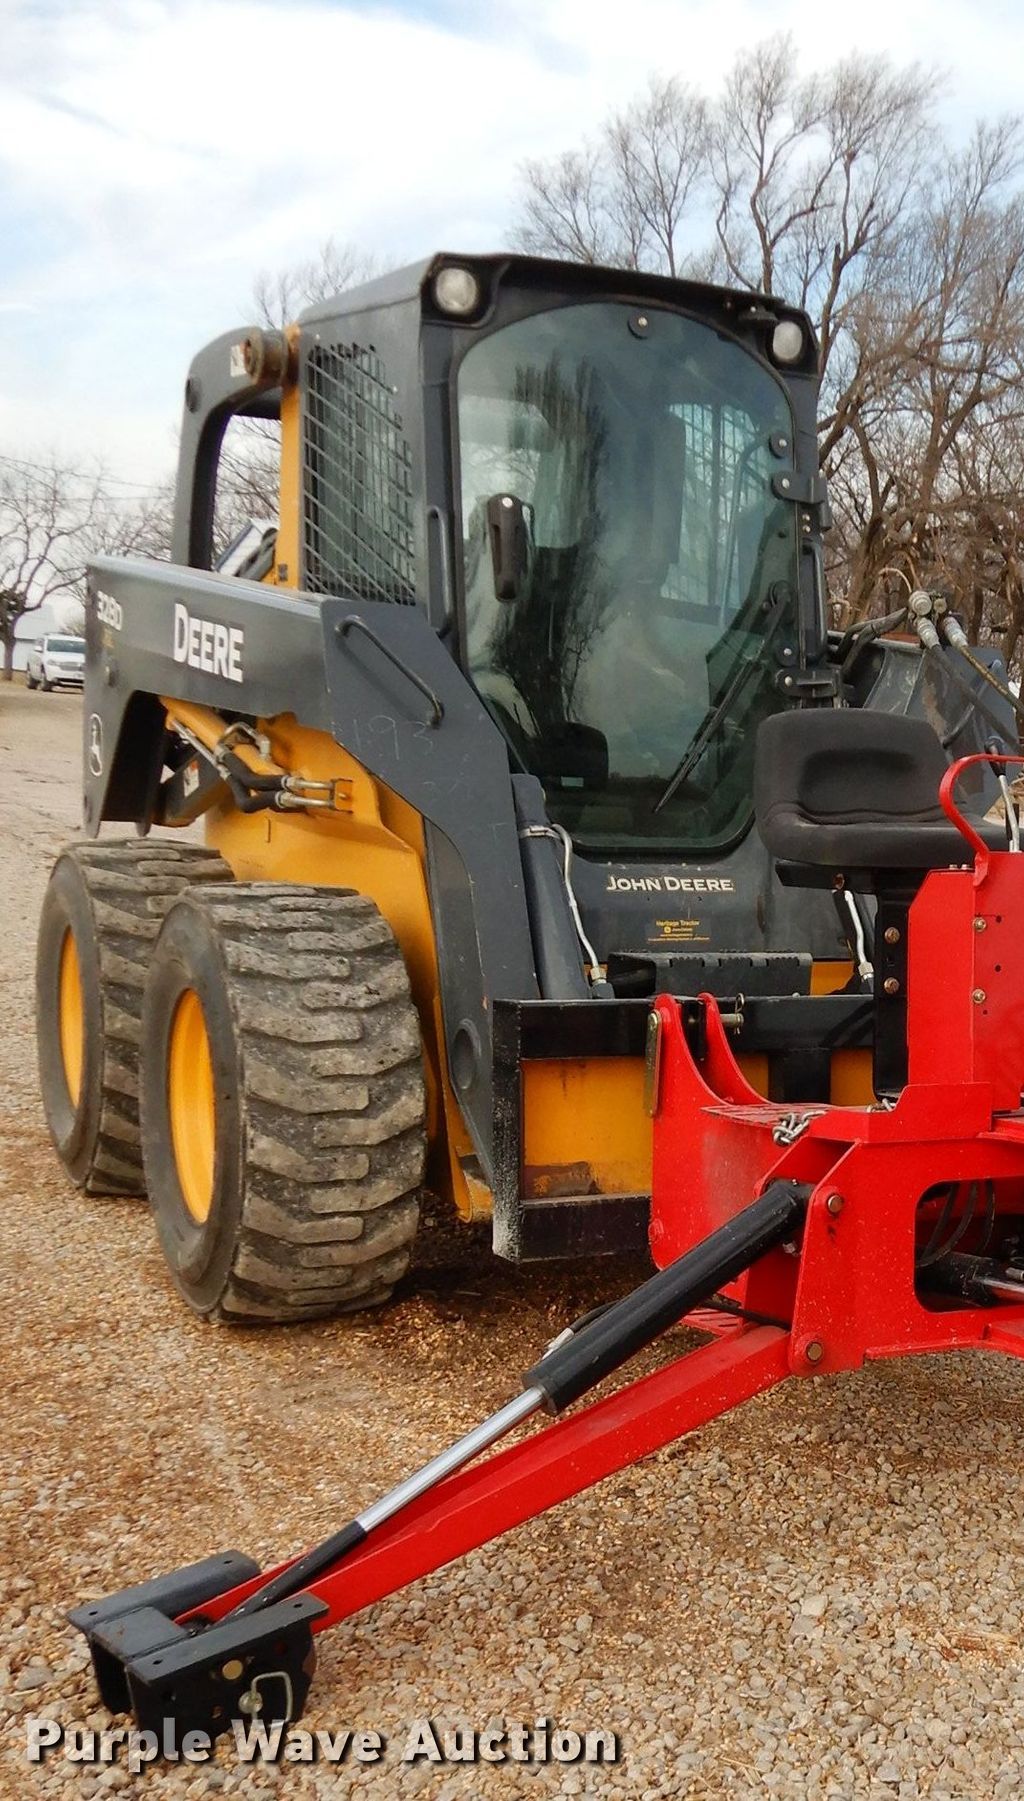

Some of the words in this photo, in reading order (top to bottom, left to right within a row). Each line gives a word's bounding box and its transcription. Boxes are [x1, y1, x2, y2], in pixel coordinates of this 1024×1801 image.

[174, 603, 244, 683] DEERE
[606, 876, 661, 891] JOHN
[663, 876, 734, 891] DEERE
